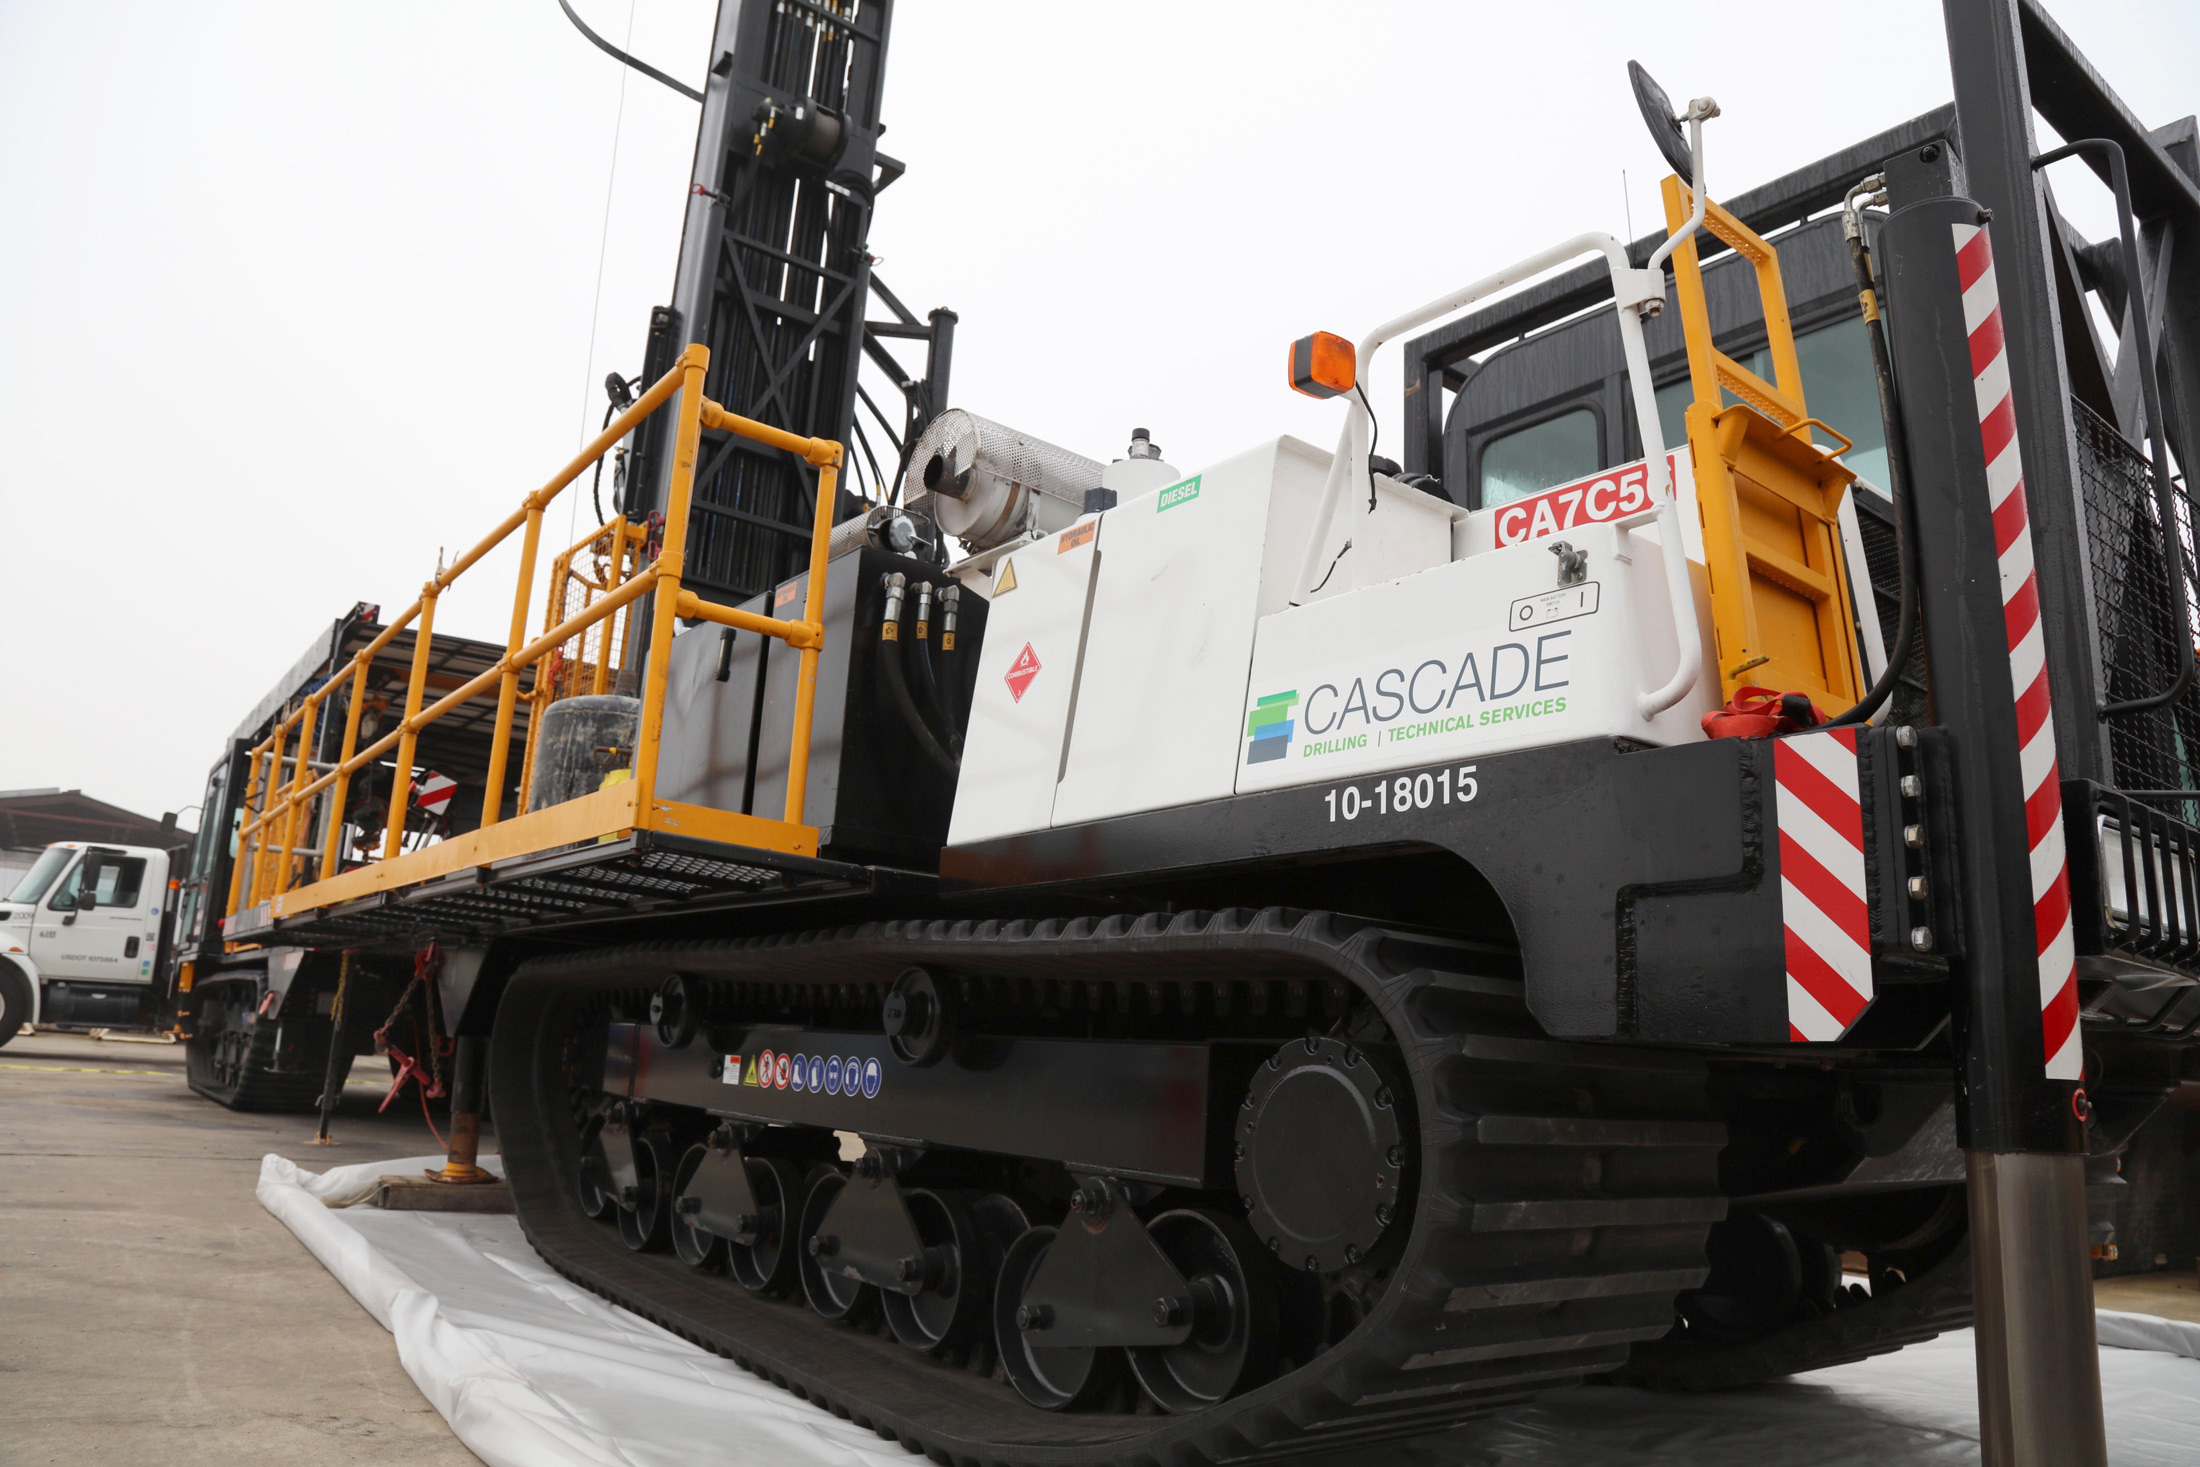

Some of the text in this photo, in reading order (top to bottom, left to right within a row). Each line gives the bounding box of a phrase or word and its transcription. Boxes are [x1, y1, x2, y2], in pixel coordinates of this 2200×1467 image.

[1160, 481, 1197, 508] DIESEL
[1499, 463, 1674, 546] CA7C5
[1060, 522, 1095, 543] HYDRAULIC
[1070, 538, 1080, 547] OIL
[1304, 630, 1571, 735] CASCADE
[1303, 697, 1567, 758] DRILLING TECHNICAL SERVICES
[1325, 765, 1478, 822] 10-18015
[61, 953, 87, 961] USDOT
